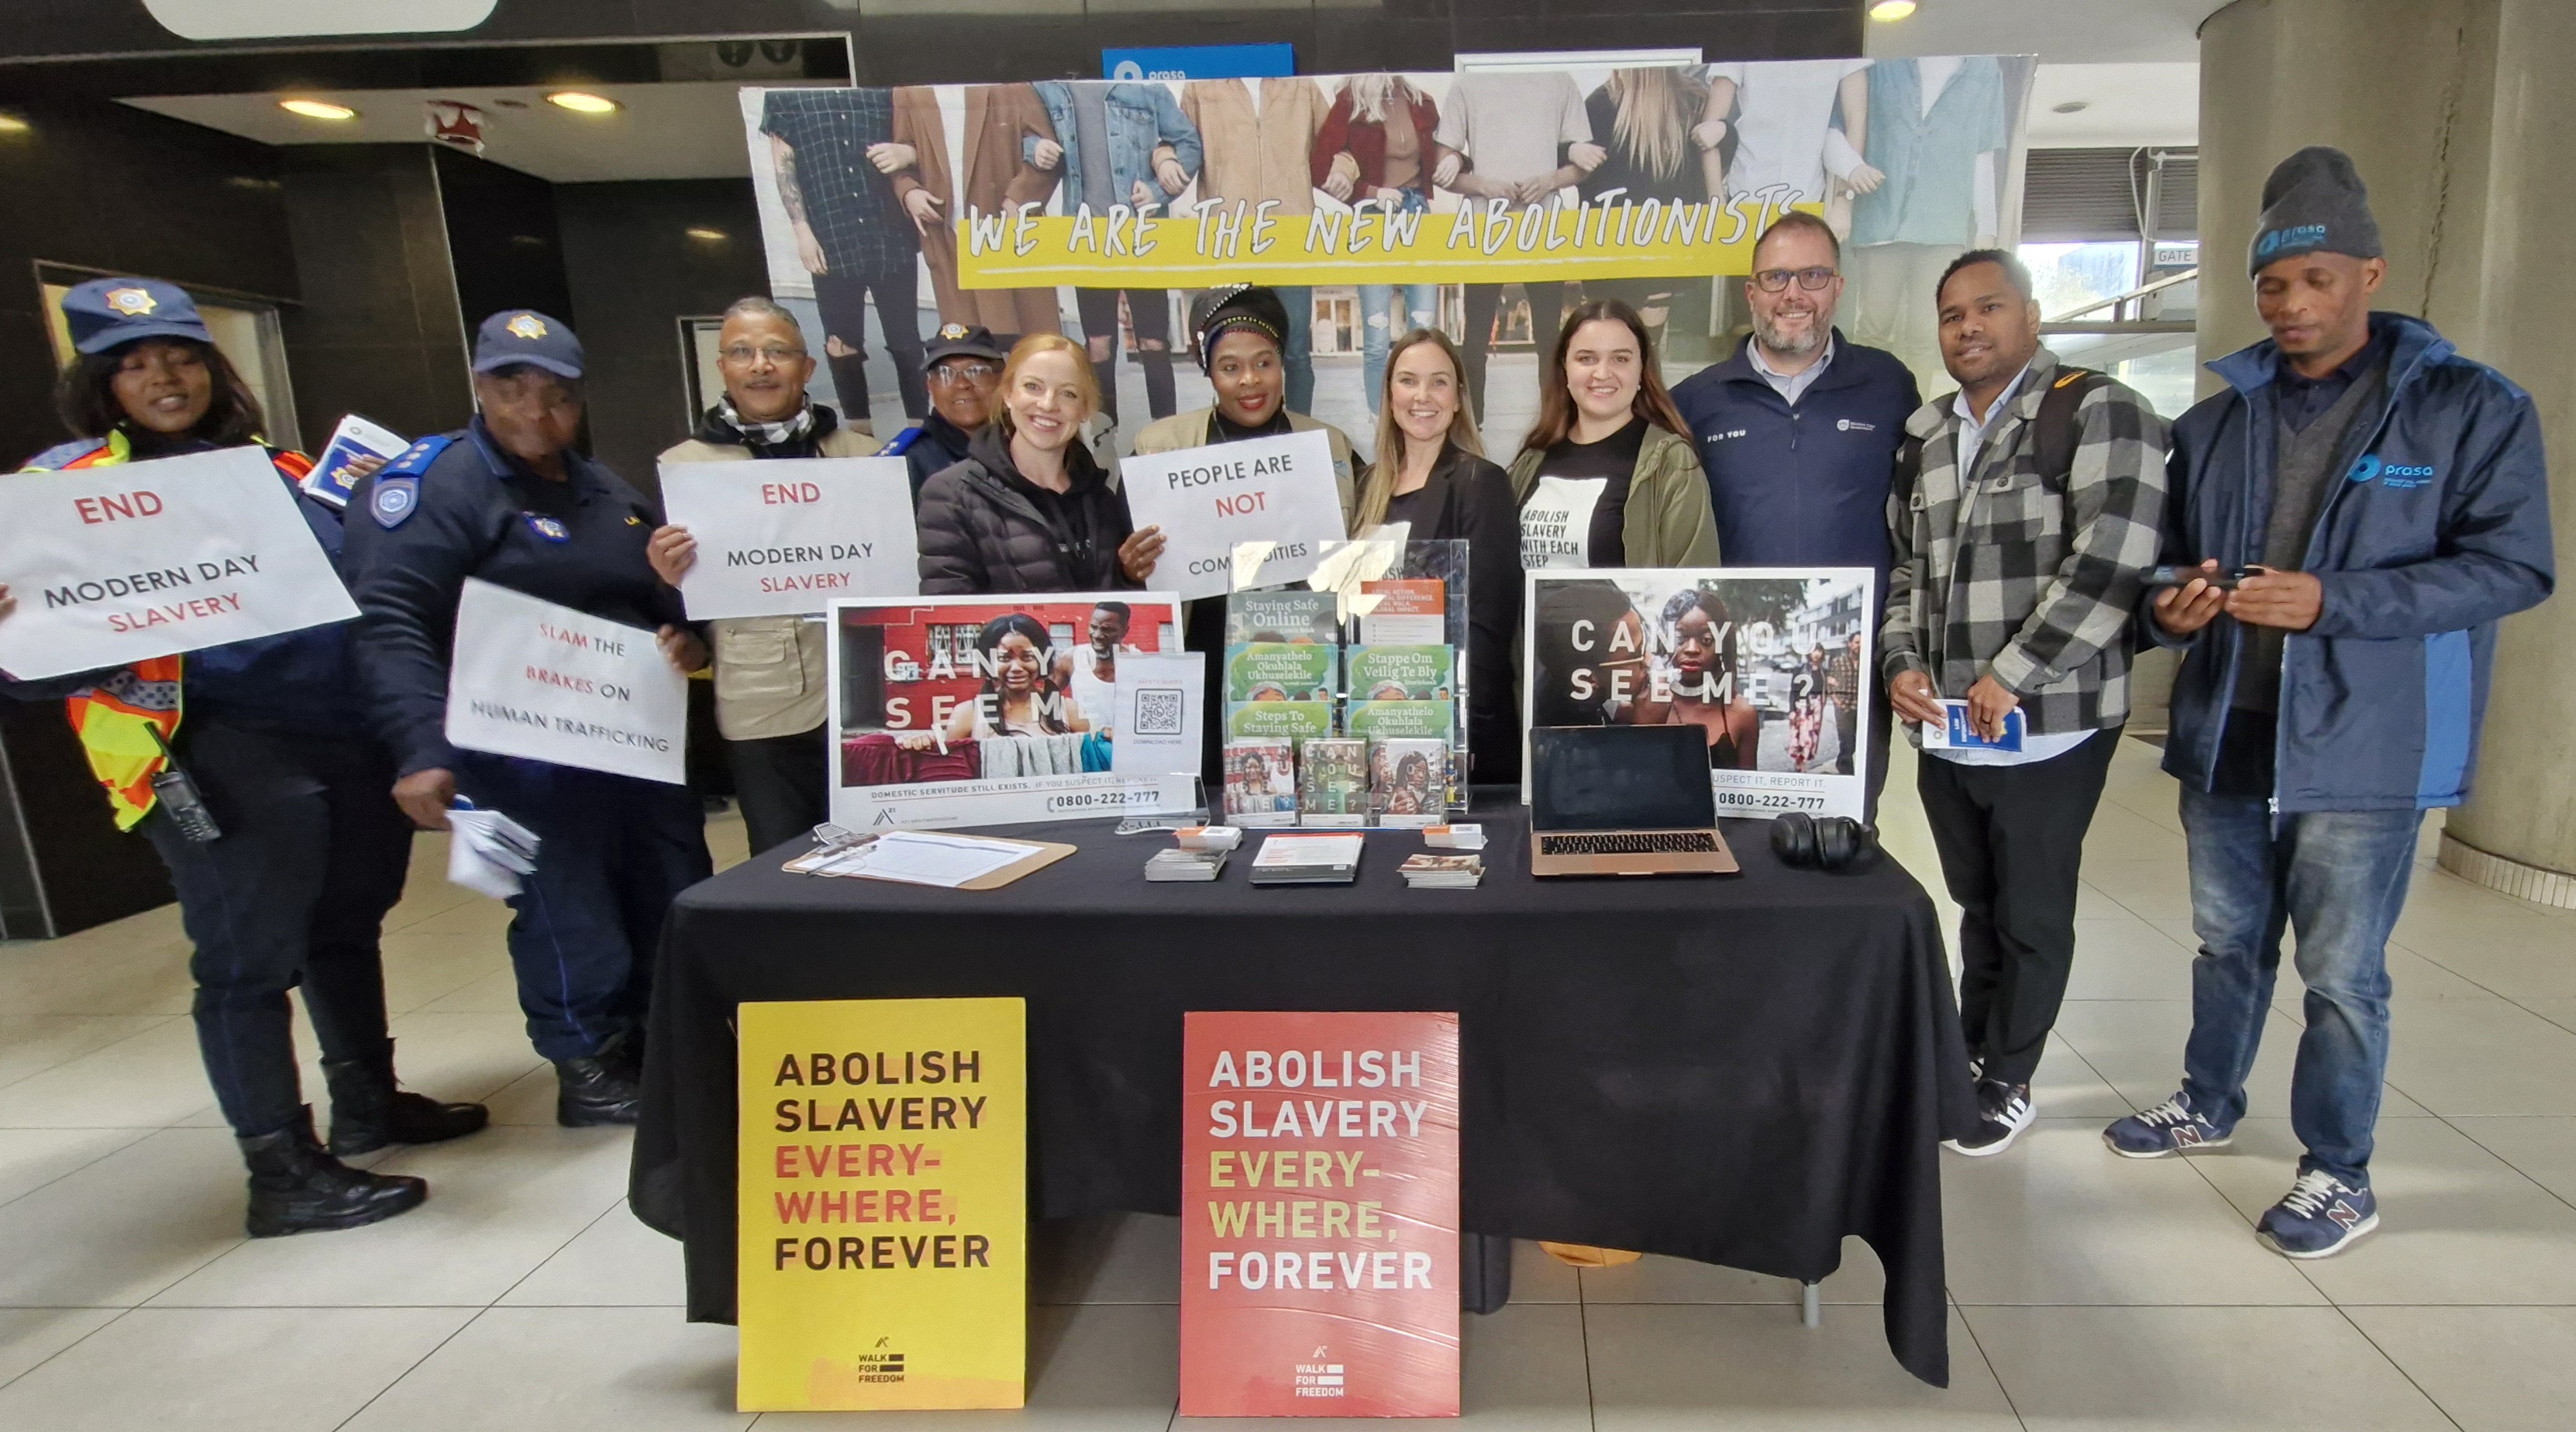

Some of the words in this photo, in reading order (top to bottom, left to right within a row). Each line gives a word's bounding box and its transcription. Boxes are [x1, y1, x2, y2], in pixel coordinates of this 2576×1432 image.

[969, 201, 1042, 257] WE
[1067, 202, 1162, 258] ARE
[1191, 197, 1281, 259] THE
[1303, 197, 1424, 256] NEW
[2158, 250, 2192, 262] GATE
[1707, 433, 1724, 443] FOR
[1727, 429, 1746, 439] YOU
[1167, 462, 1246, 490] PEOPLE
[1253, 454, 1293, 477] ARE
[2385, 465, 2433, 477] prasa
[762, 482, 821, 504] END
[74, 491, 163, 525] END
[1215, 491, 1266, 518] NOT
[1523, 509, 1569, 523] ABOLISH
[1520, 523, 1566, 539] SLAVERY
[728, 546, 824, 566] MODERN
[830, 542, 873, 560] DAY
[1520, 539, 1547, 553] WITH
[1551, 542, 1579, 556] EACH
[1189, 542, 1307, 575] COMDITIES
[1523, 554, 1548, 568] STEP
[43, 566, 192, 608] MODERN
[197, 554, 260, 581] DAY
[760, 572, 851, 593] SLAVERY
[108, 592, 243, 632] SLAVERY
[1246, 600, 1291, 614] Staying
[1293, 599, 1319, 611] Safe
[1253, 611, 1310, 627] Online
[539, 623, 589, 649] SLAM
[594, 636, 626, 658] THE
[1571, 618, 1675, 653] CAN
[1707, 621, 1818, 655] YOU
[884, 648, 999, 682] CAN
[1247, 651, 1312, 663] Amanyathelo
[1368, 653, 1410, 666] Stappe
[1412, 652, 1433, 664] Om
[1257, 661, 1302, 670] Okuhlala
[1364, 666, 1400, 680] Veilig
[1400, 666, 1415, 676] Te
[1418, 666, 1438, 680] Bly
[1248, 670, 1312, 680] Ukhuselekile
[526, 665, 594, 694] BRAKES
[599, 683, 630, 702] ON
[1570, 668, 1672, 703] SEE
[885, 694, 999, 730] SEE
[1255, 711, 1286, 725] Steps
[1290, 711, 1304, 721] To
[1367, 706, 1434, 719] Amanyathelo
[470, 698, 549, 729] HUMAN
[554, 715, 670, 752] TRAFFICKING
[1243, 723, 1288, 735] Staying
[1291, 722, 1317, 733] Safe
[1377, 716, 1423, 725] Okuhlala
[1368, 725, 1434, 735] Ukhuselekile
[1306, 745, 1357, 759] CAN
[1307, 763, 1357, 775] YOU
[1307, 780, 1357, 793] SEE
[1713, 774, 1752, 785] USPECT
[1770, 776, 1811, 787] REPORT
[872, 789, 917, 799] DOMESTIC
[920, 786, 969, 796] SERVITUDE
[972, 784, 994, 793] STILL
[1056, 791, 1159, 807] 0800-222-777
[1719, 792, 1825, 810] 0800-222-777
[774, 1050, 980, 1086] ABOLISH
[1209, 1050, 1421, 1088] ABOLISH
[775, 1096, 987, 1133] SLAVERY
[1209, 1100, 1428, 1138] SLAVERY
[776, 1143, 941, 1179] EVERY-
[1211, 1150, 1381, 1188] EVERY-
[774, 1189, 957, 1226] WHERE,
[1208, 1200, 1397, 1243] WHERE,
[775, 1234, 990, 1271] FOREVER
[1209, 1251, 1433, 1290] FOREVER
[859, 1354, 887, 1362] WALK
[859, 1365, 878, 1373] FOR
[1296, 1364, 1326, 1374] WALK
[859, 1375, 905, 1383] FREEDOM
[1296, 1375, 1316, 1386] FOR
[1296, 1387, 1345, 1397] FREEDOM
